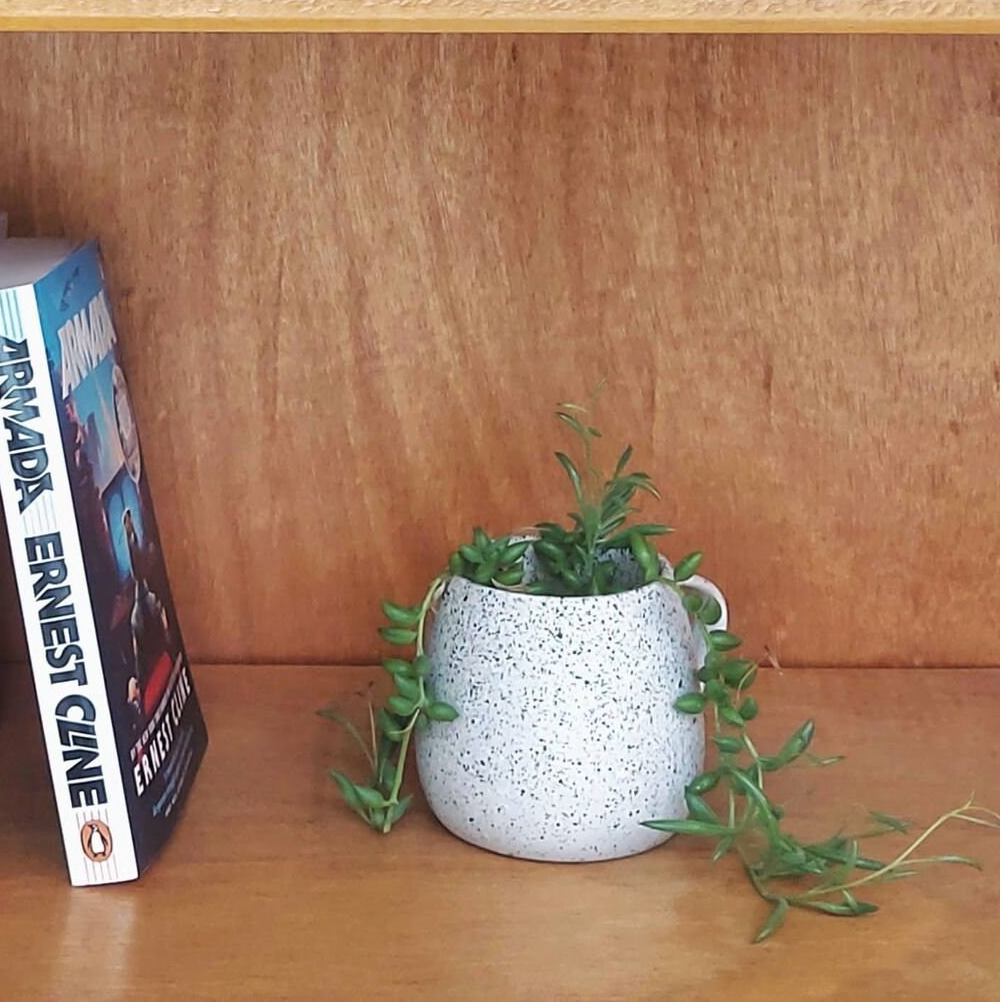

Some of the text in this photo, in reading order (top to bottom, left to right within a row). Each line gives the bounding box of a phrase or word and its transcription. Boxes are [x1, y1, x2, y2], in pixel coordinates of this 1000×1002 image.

[24, 532, 88, 686] ERNEST
[55, 694, 108, 809] CLINE
[133, 713, 174, 797] ERNEST
[170, 666, 191, 727] CLINE
